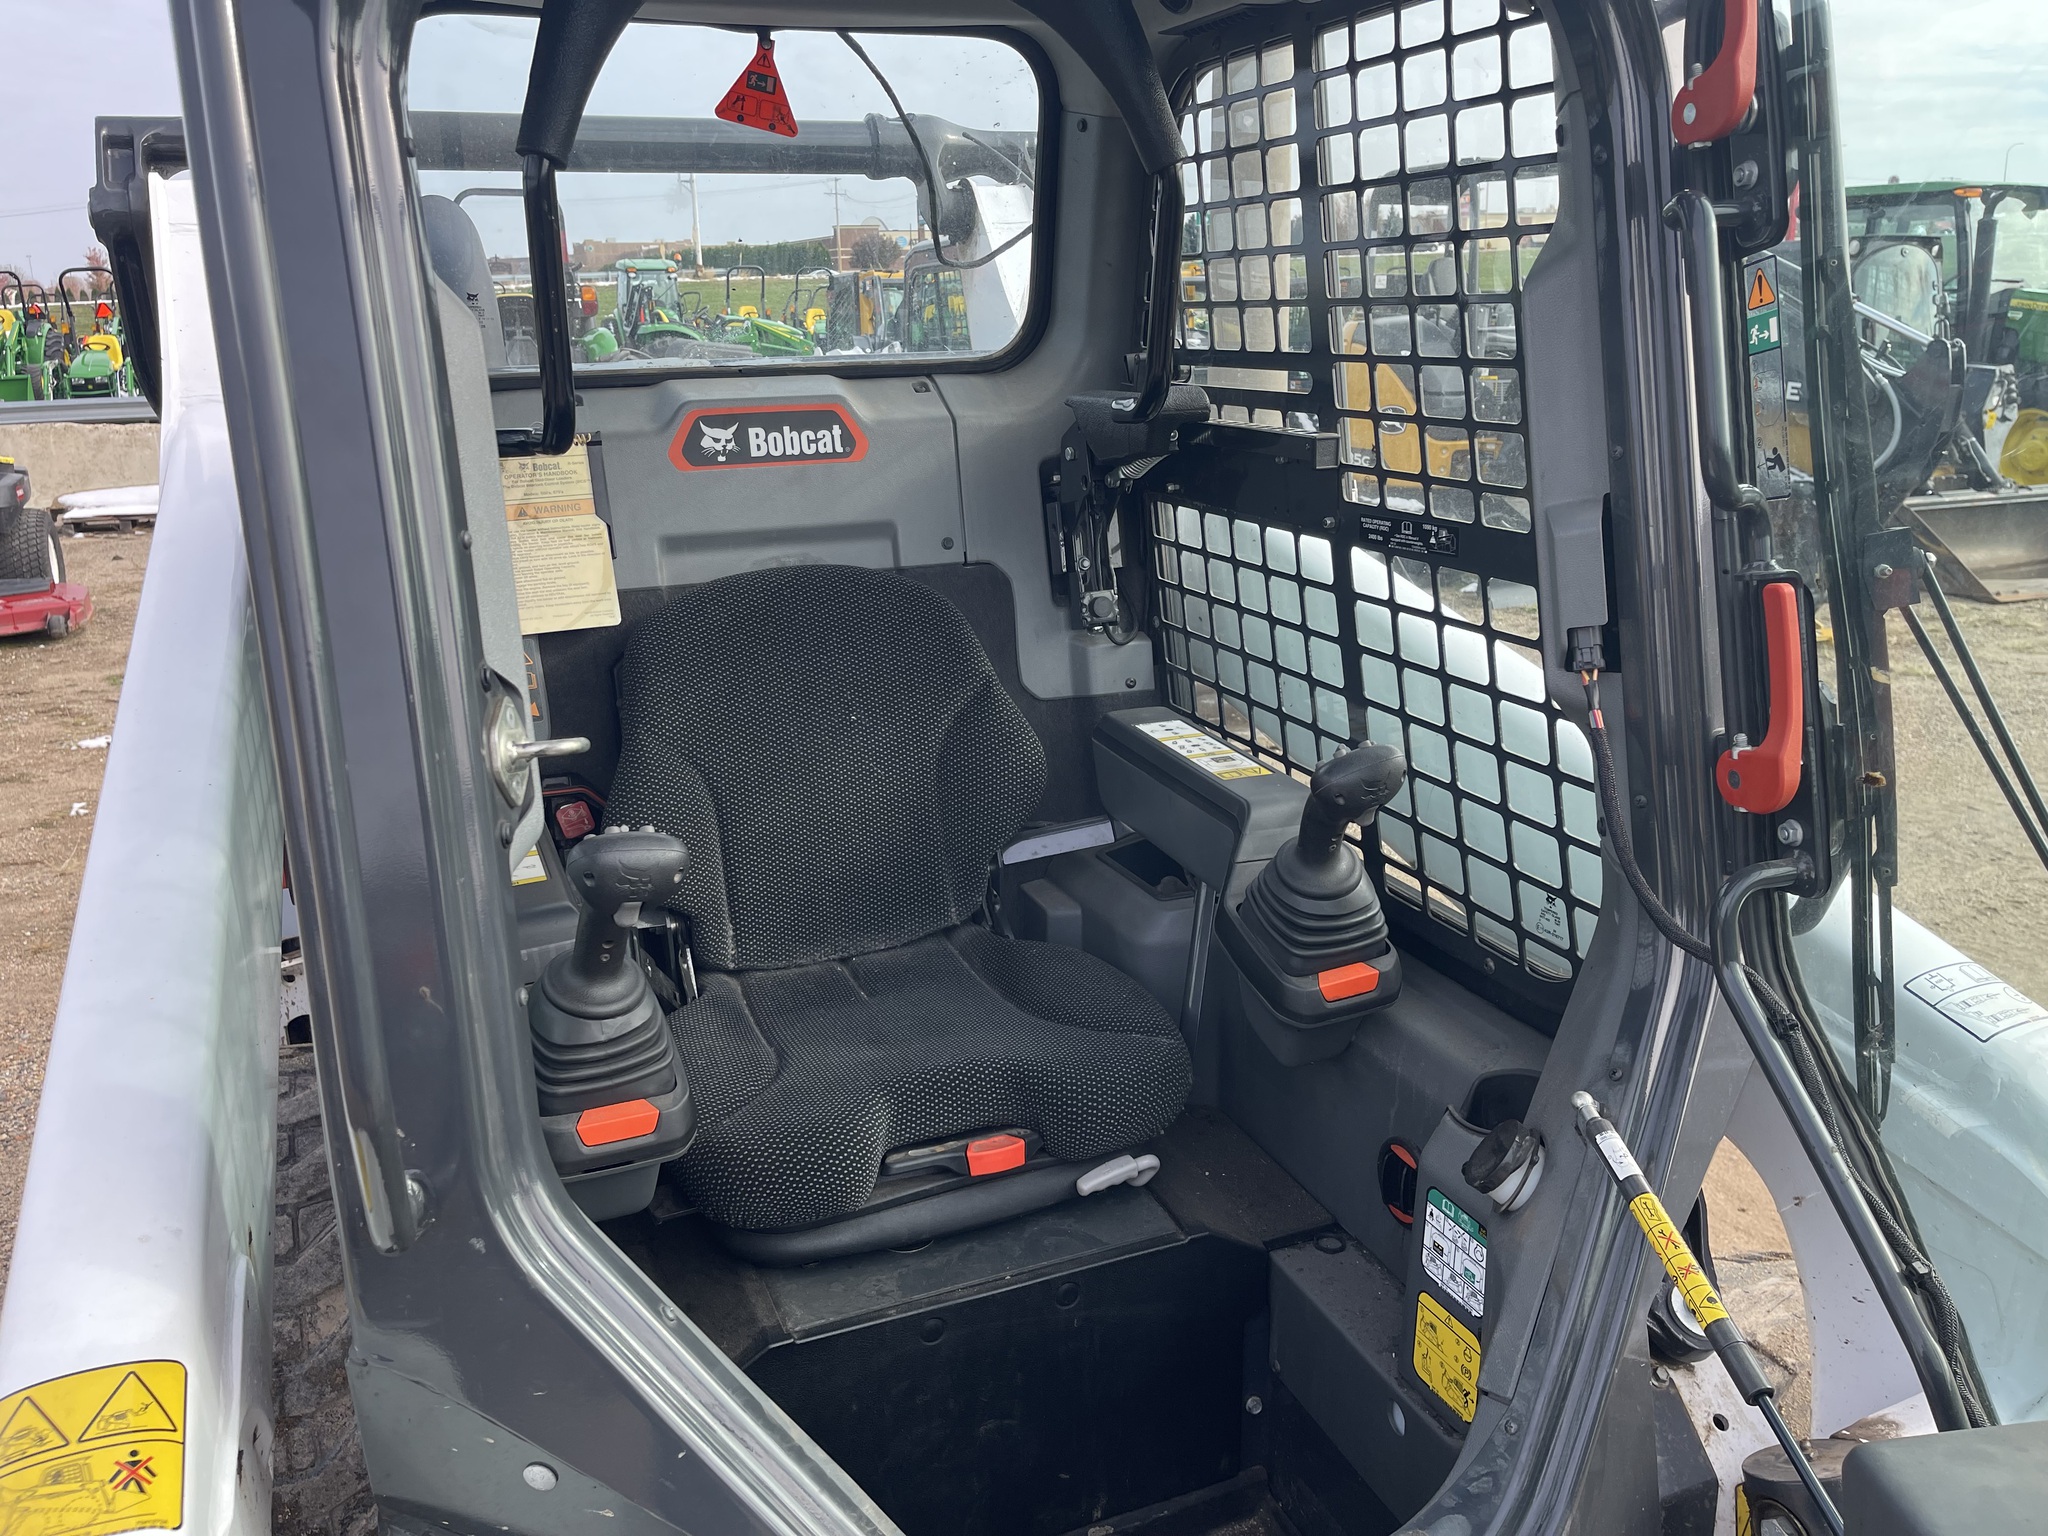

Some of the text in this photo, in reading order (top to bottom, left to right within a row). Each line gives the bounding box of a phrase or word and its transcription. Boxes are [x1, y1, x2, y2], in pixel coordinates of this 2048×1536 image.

[748, 425, 844, 457] Bobcat
[533, 462, 562, 471] Bobcat
[504, 472, 542, 480] OPERATOR'S
[534, 503, 581, 514] WARNING
